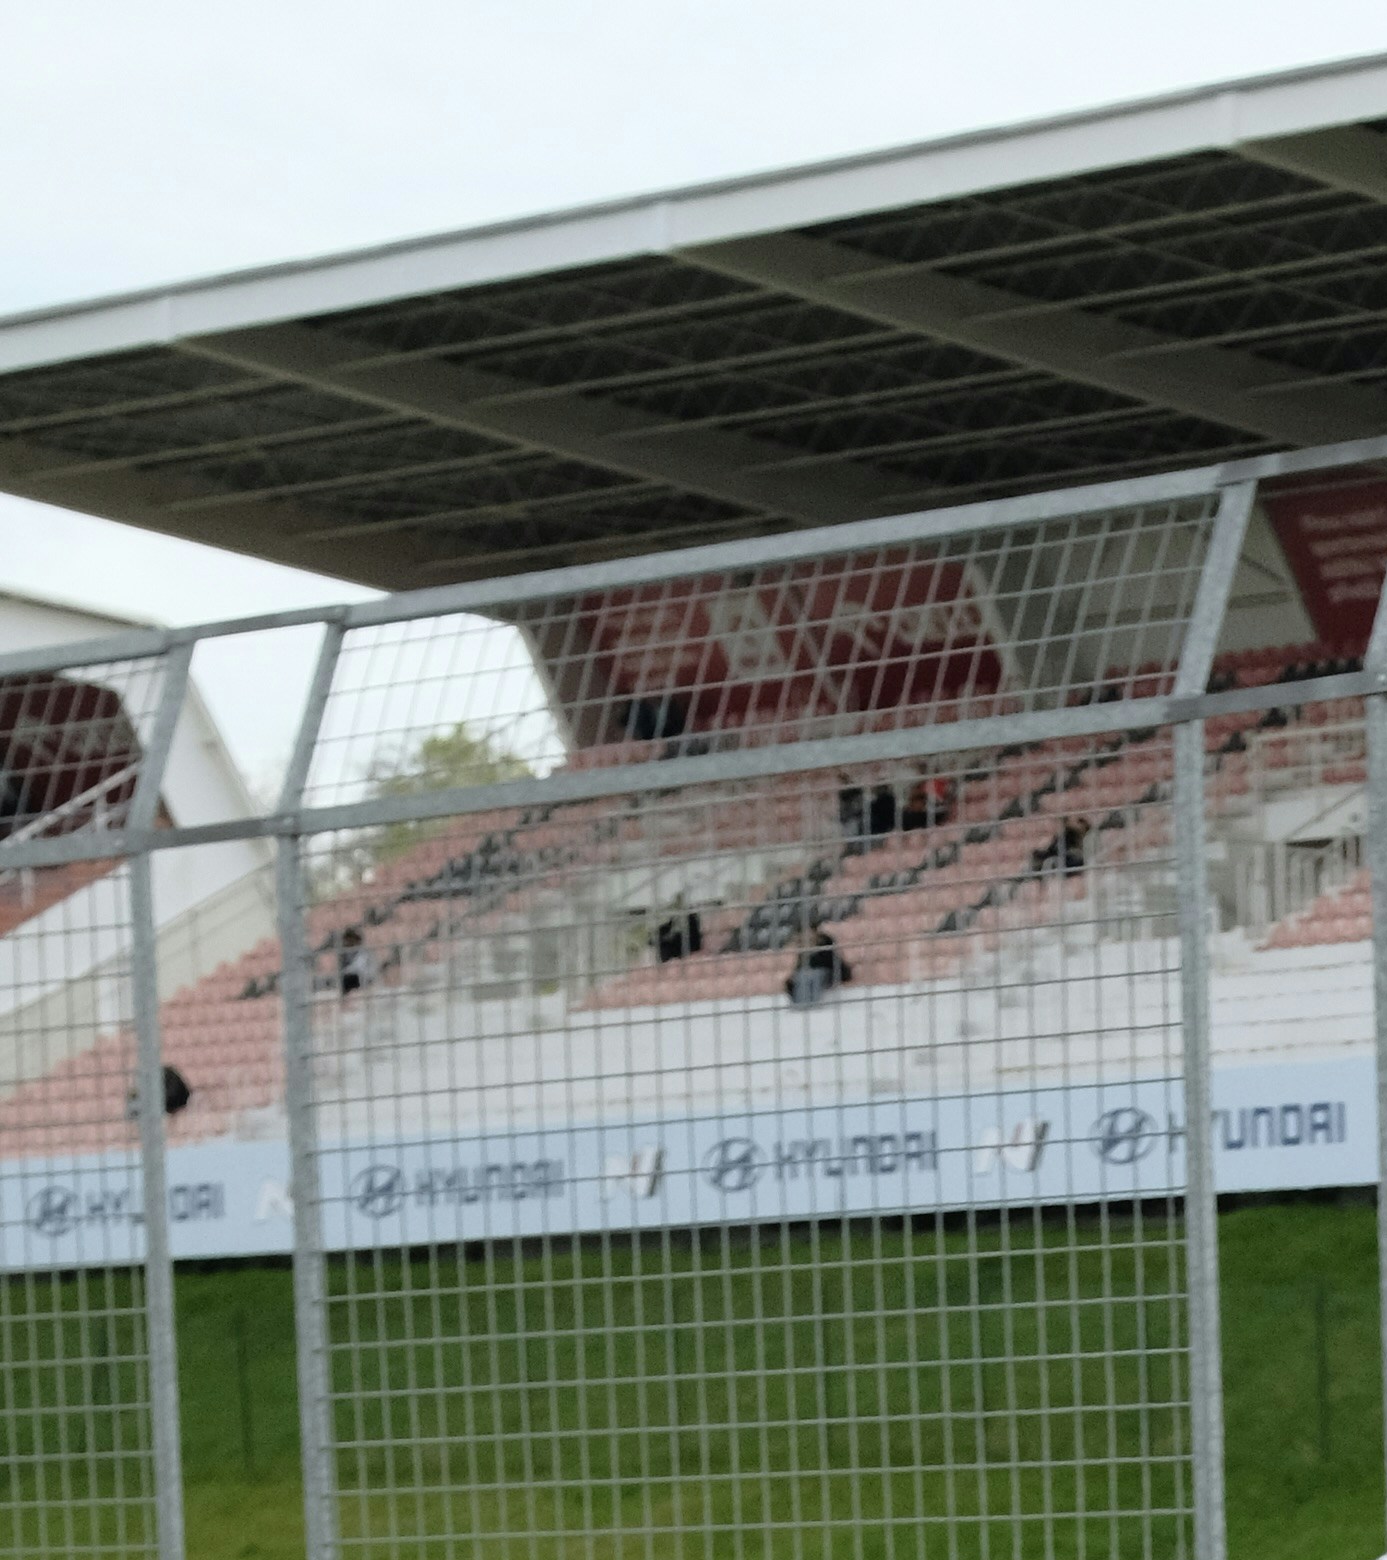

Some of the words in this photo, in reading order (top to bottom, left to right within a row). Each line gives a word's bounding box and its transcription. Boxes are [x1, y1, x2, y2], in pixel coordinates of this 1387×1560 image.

[1169, 1101, 1346, 1154] HUNDAI
[773, 1130, 937, 1181] HYUNDAI
[86, 1181, 226, 1226] HYDAI
